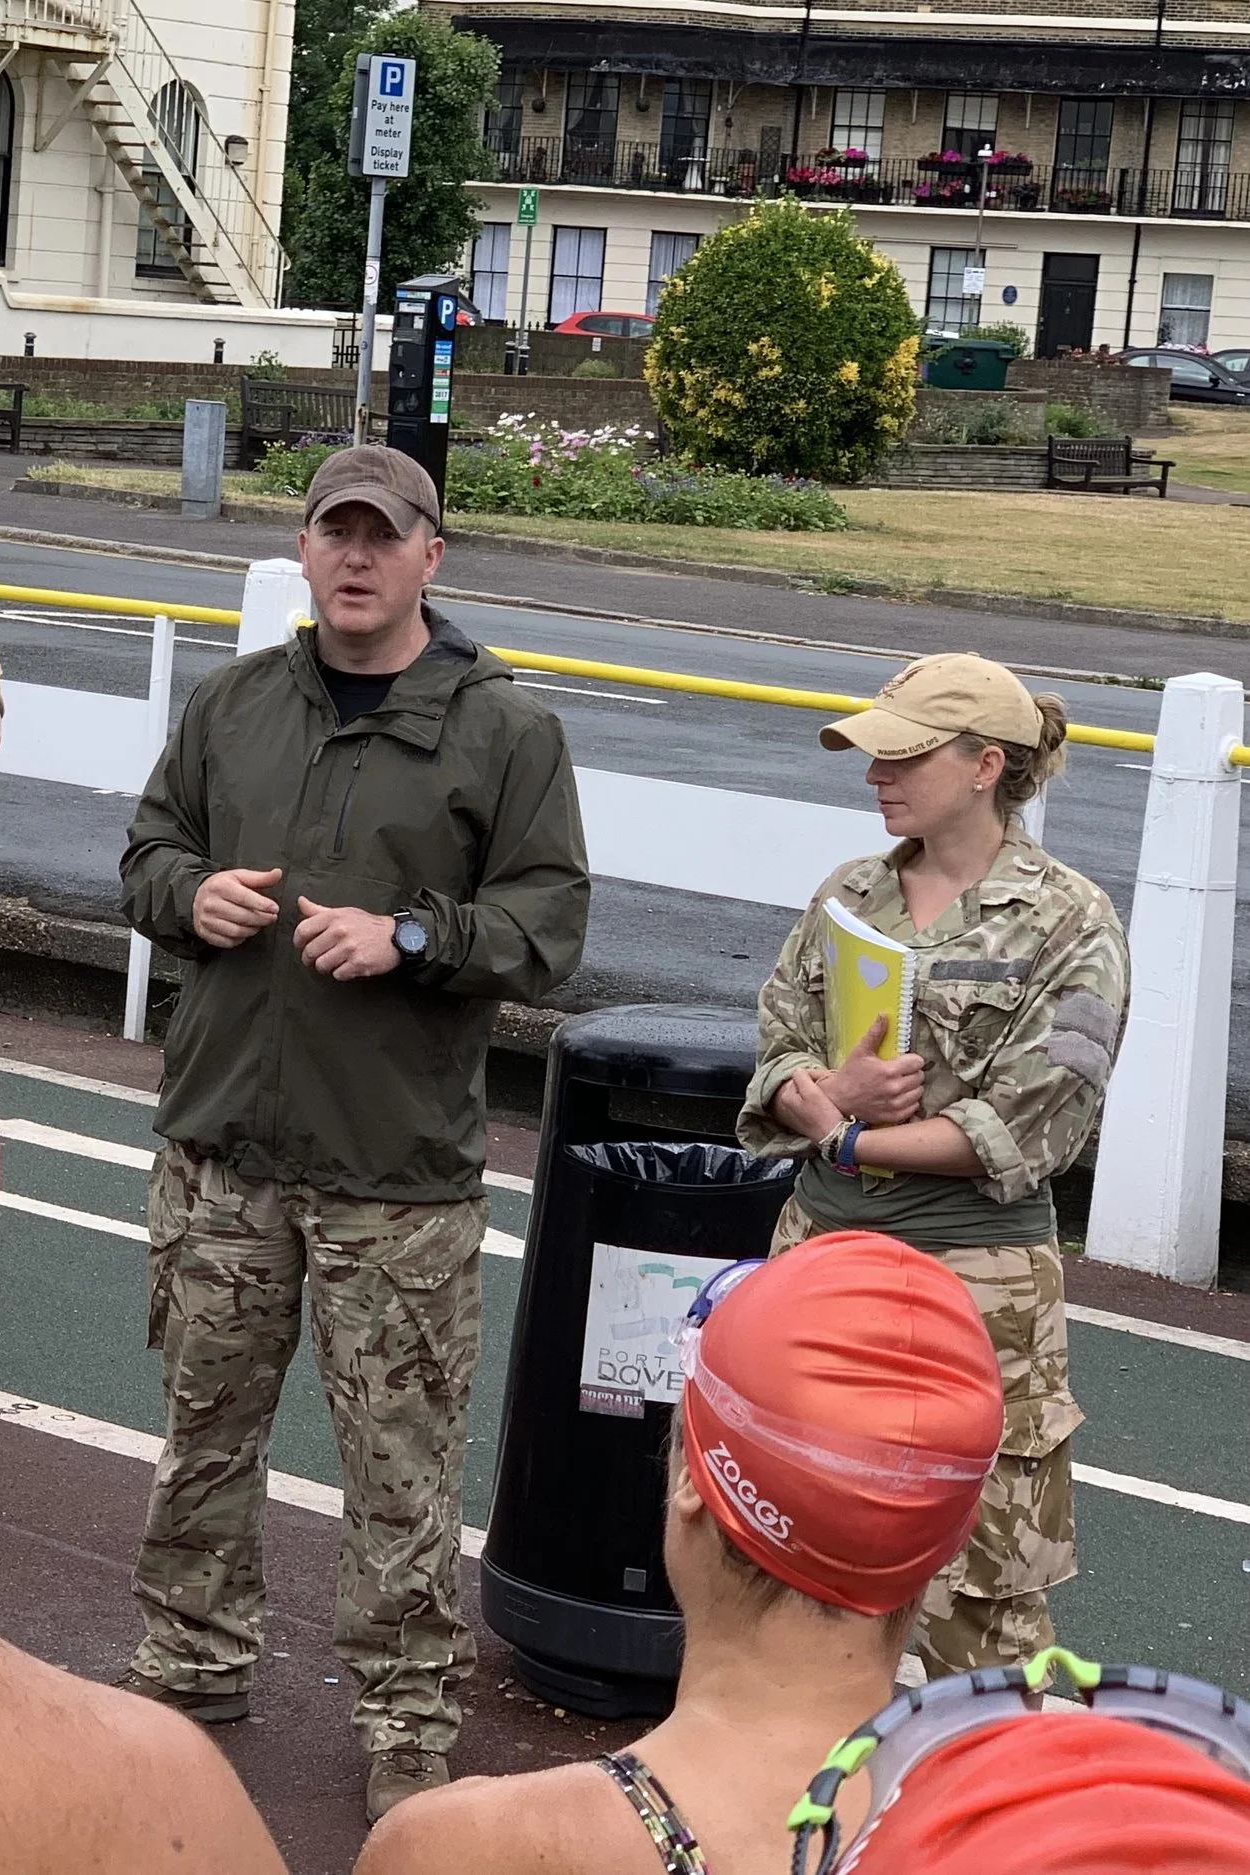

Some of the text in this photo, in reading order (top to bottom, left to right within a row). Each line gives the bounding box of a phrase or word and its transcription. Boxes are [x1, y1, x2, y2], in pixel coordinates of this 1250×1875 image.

[385, 66, 402, 93] P
[371, 100, 410, 113] Pay here
[384, 114, 394, 125] at
[375, 128, 402, 138] meter
[371, 146, 404, 160] Display
[373, 160, 399, 171] ticket
[441, 299, 454, 325] P
[877, 736, 939, 756] WARRIOR ELITE OPS
[599, 1347, 667, 1369] PORT
[597, 1360, 687, 1391] DOVE
[708, 1440, 794, 1540] ZOGGS
